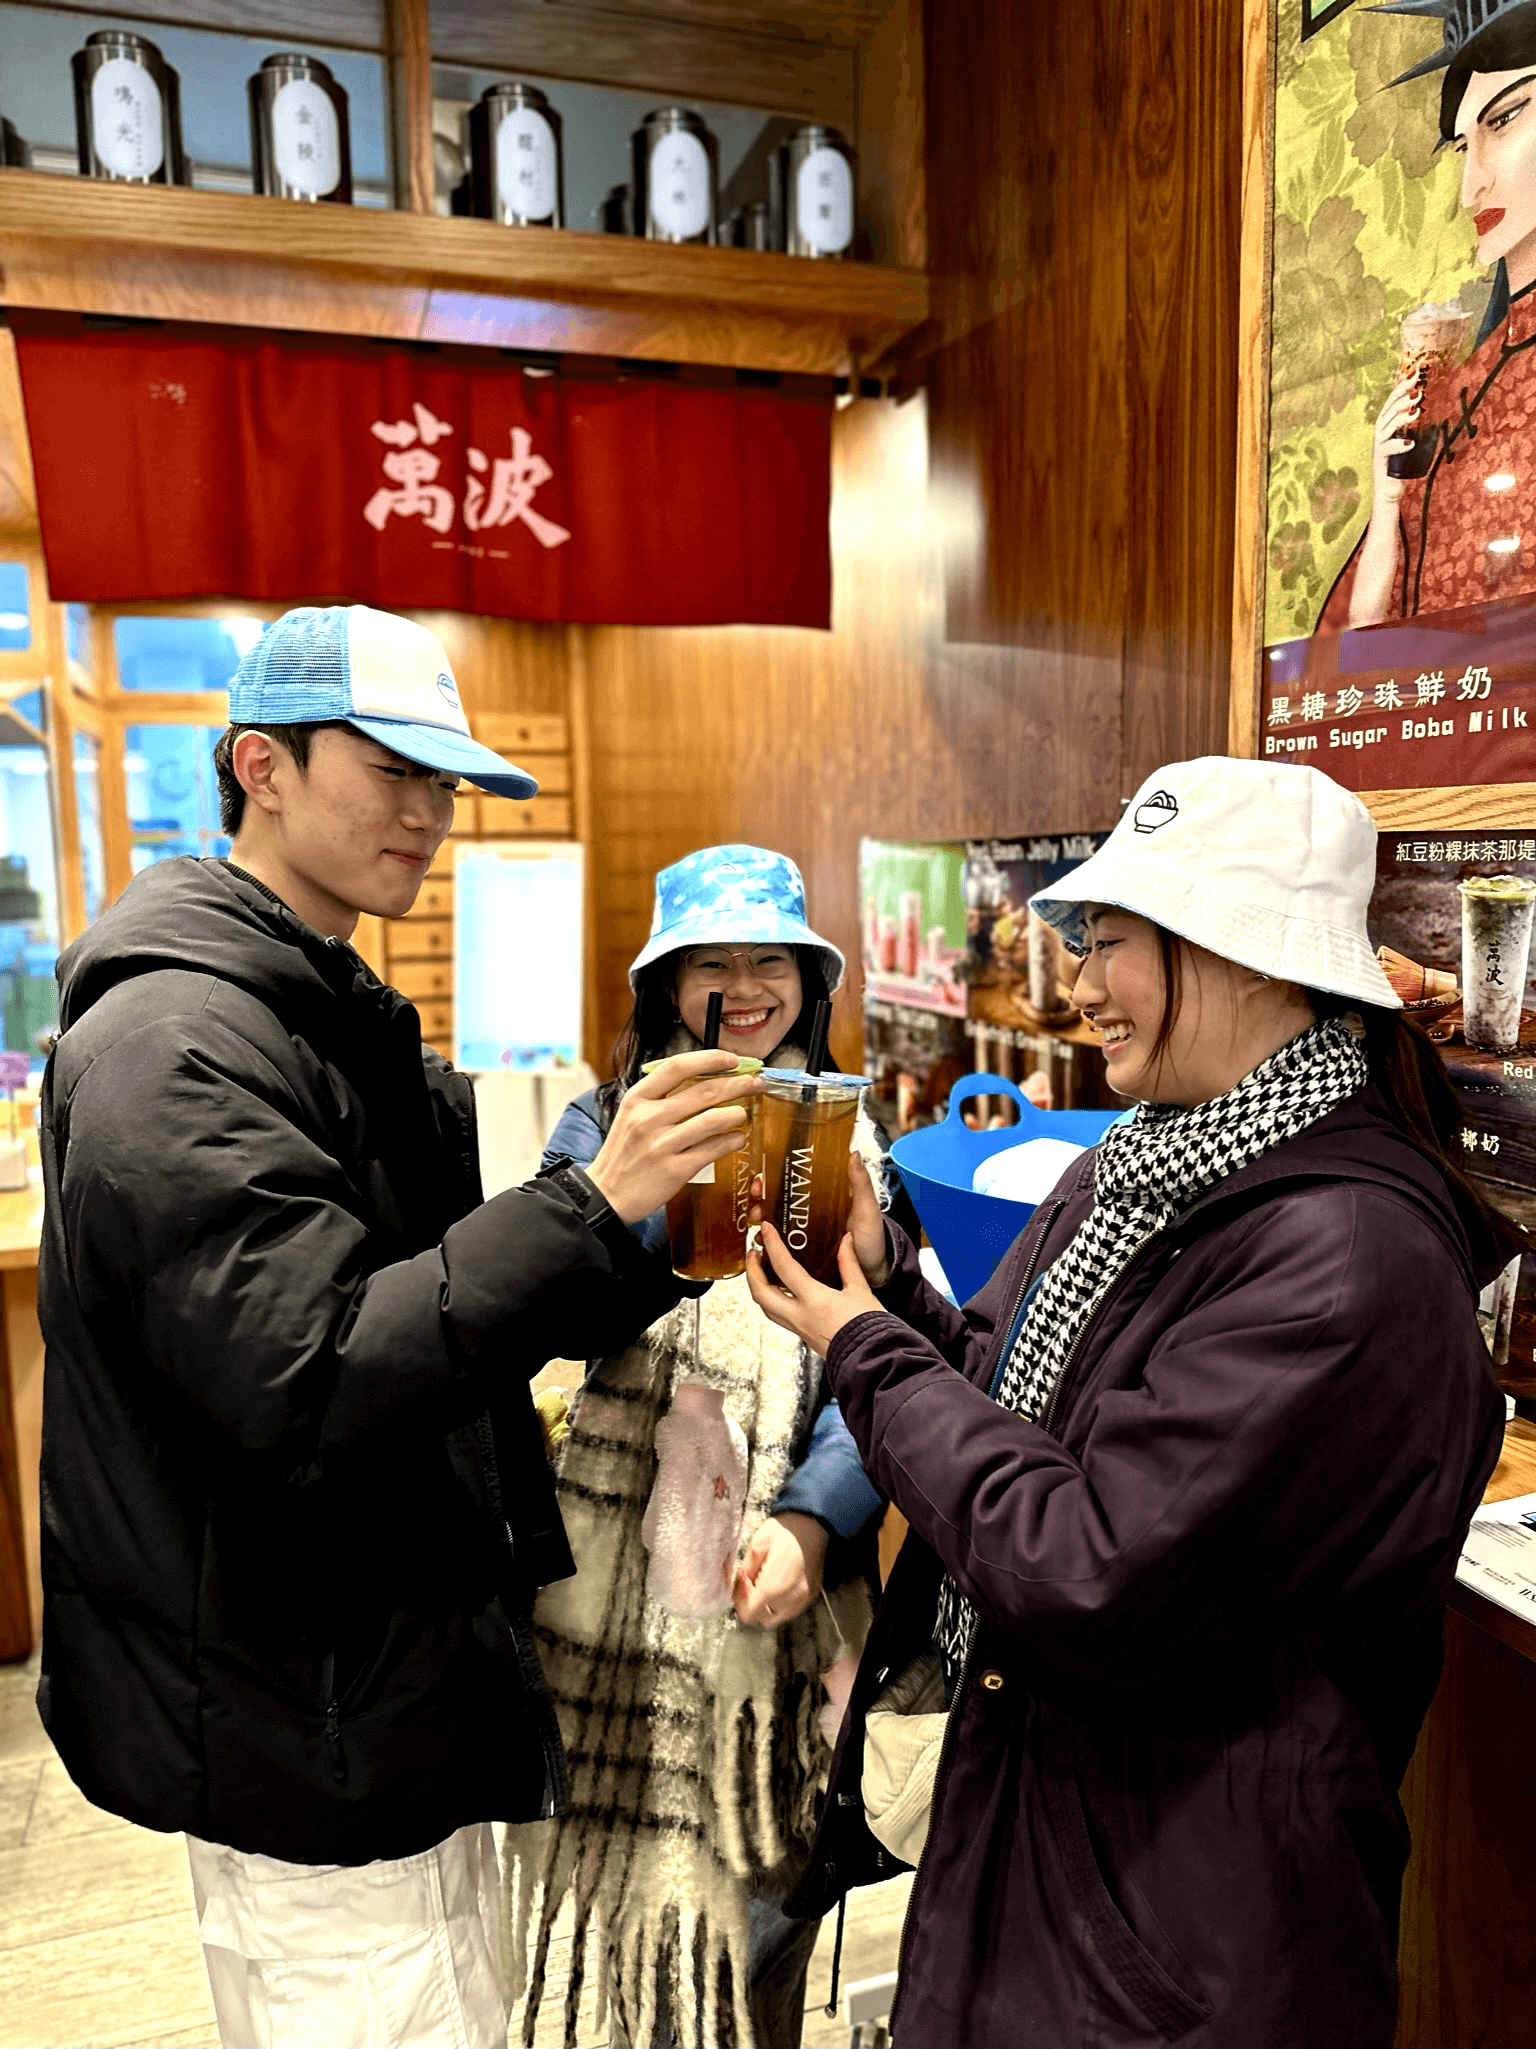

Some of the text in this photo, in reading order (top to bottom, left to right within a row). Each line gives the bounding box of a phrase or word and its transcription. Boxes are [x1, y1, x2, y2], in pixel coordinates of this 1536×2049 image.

[363, 402, 572, 549] 萬波
[1267, 665, 1493, 727] 黑糖珍珠鮮奶
[1265, 707, 1528, 754] Brown Sugar Boba Milk
[1486, 940, 1504, 985] 萬波
[1504, 1061, 1533, 1080] Red
[787, 1144, 814, 1250] WANPO
